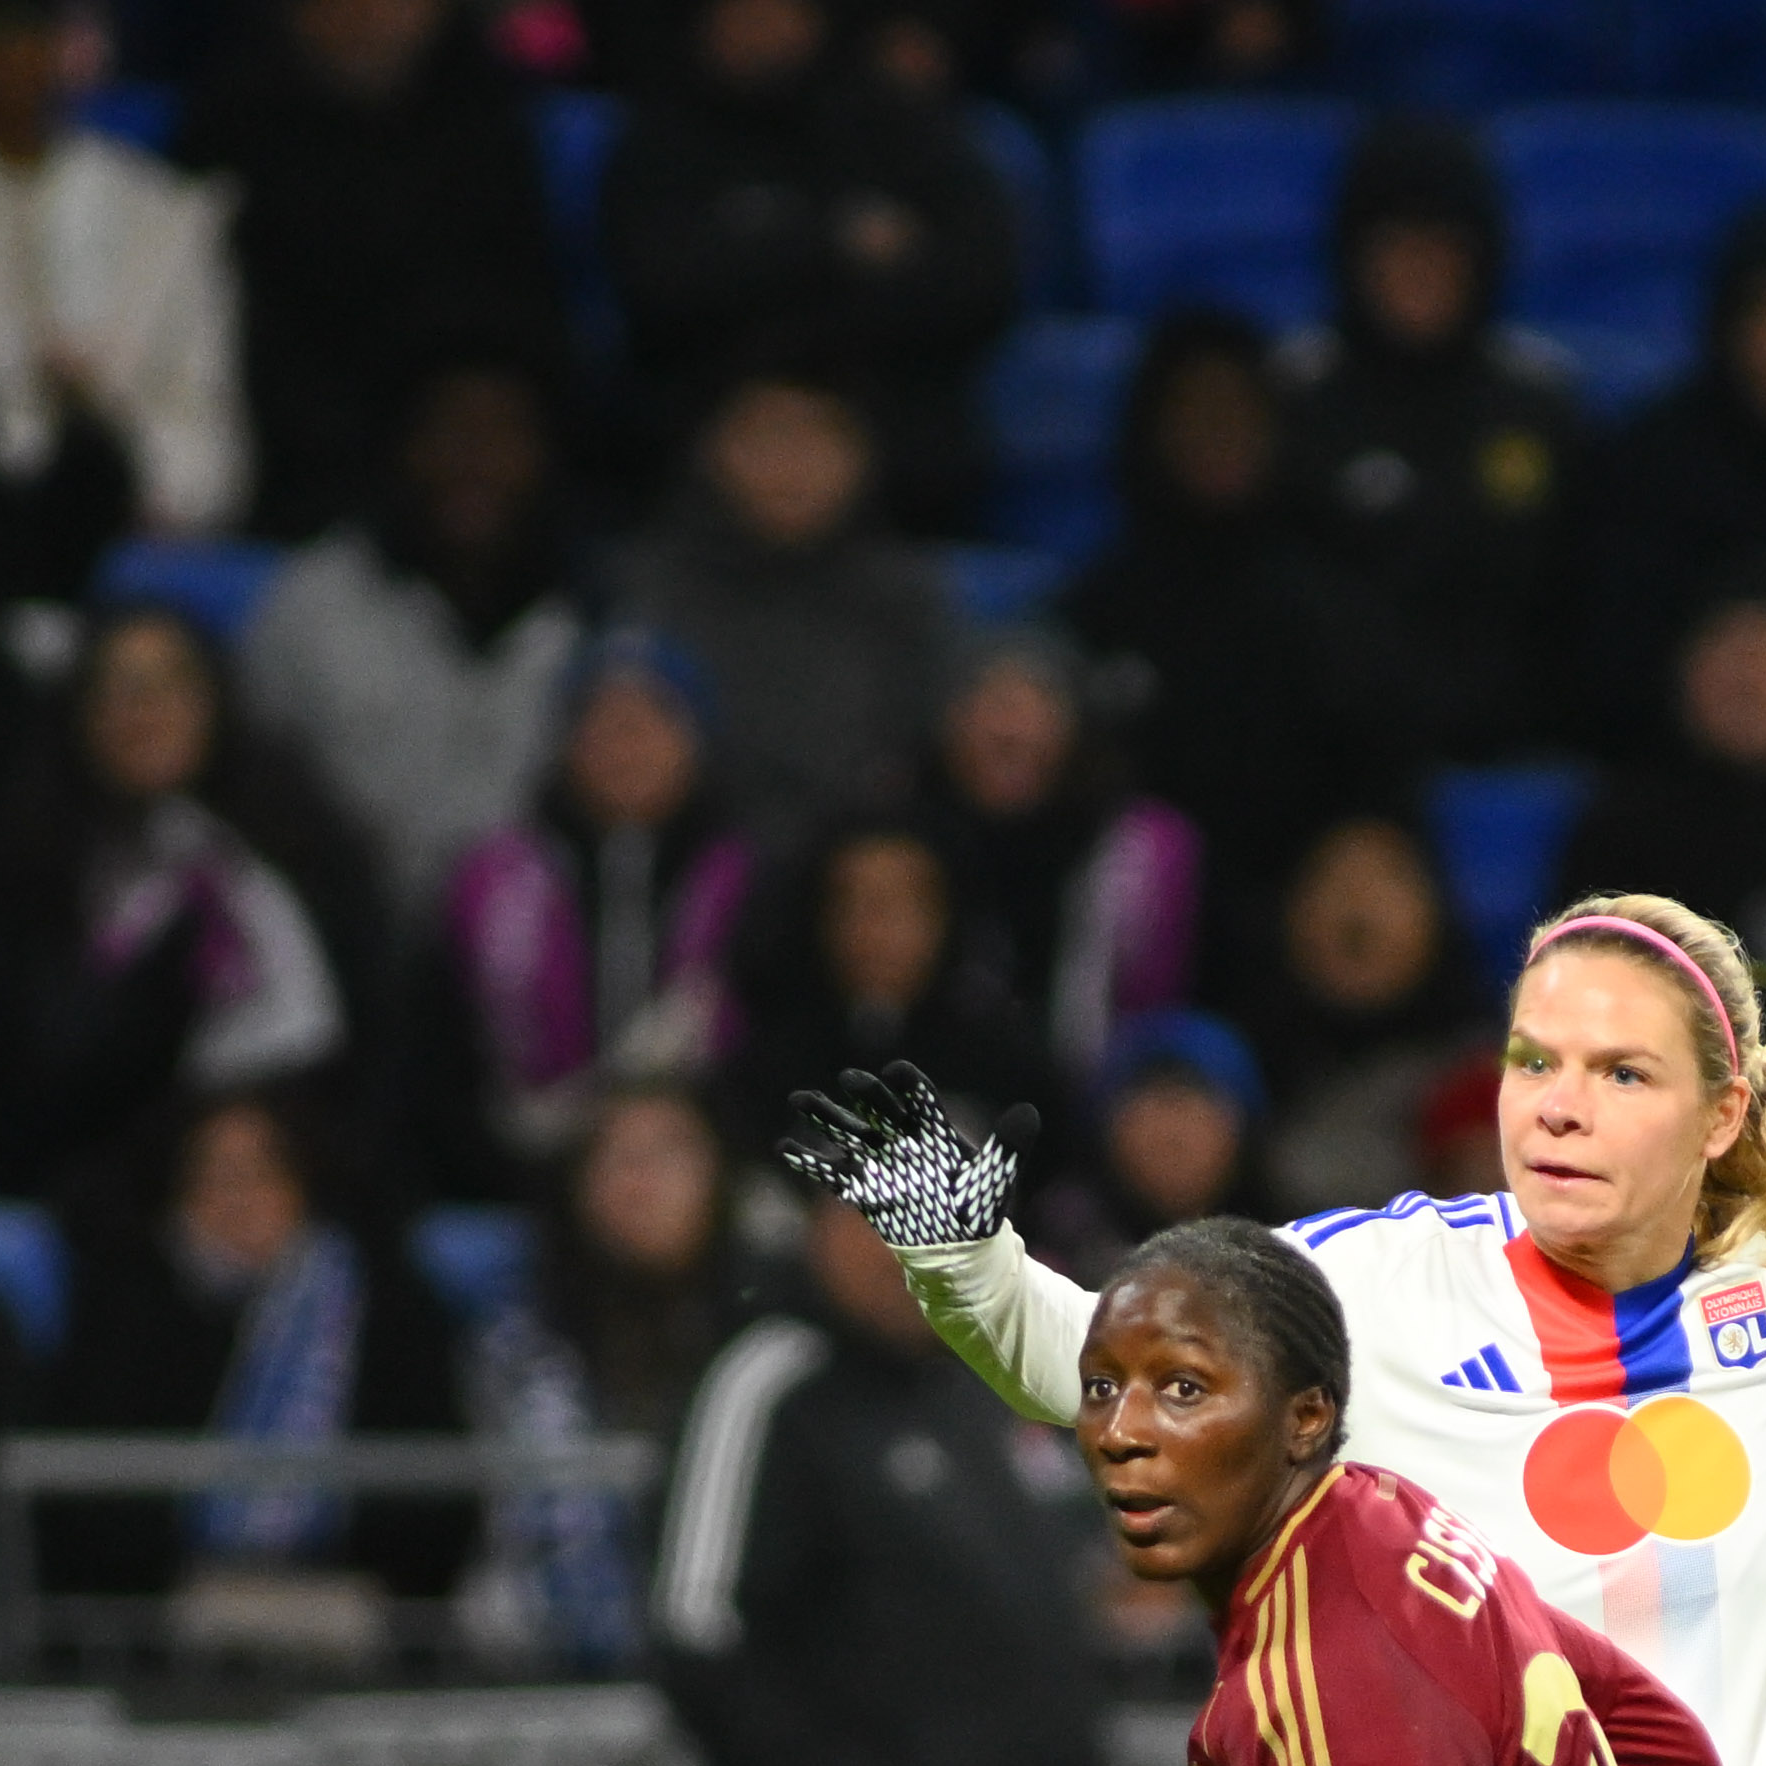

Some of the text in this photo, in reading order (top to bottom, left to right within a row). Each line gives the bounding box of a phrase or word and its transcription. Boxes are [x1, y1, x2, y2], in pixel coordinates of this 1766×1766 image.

[1704, 1285, 1761, 1311] OLYMPIQUE
[1707, 1297, 1763, 1322] LYONNAIS
[1405, 1504, 1500, 1619] CISS
